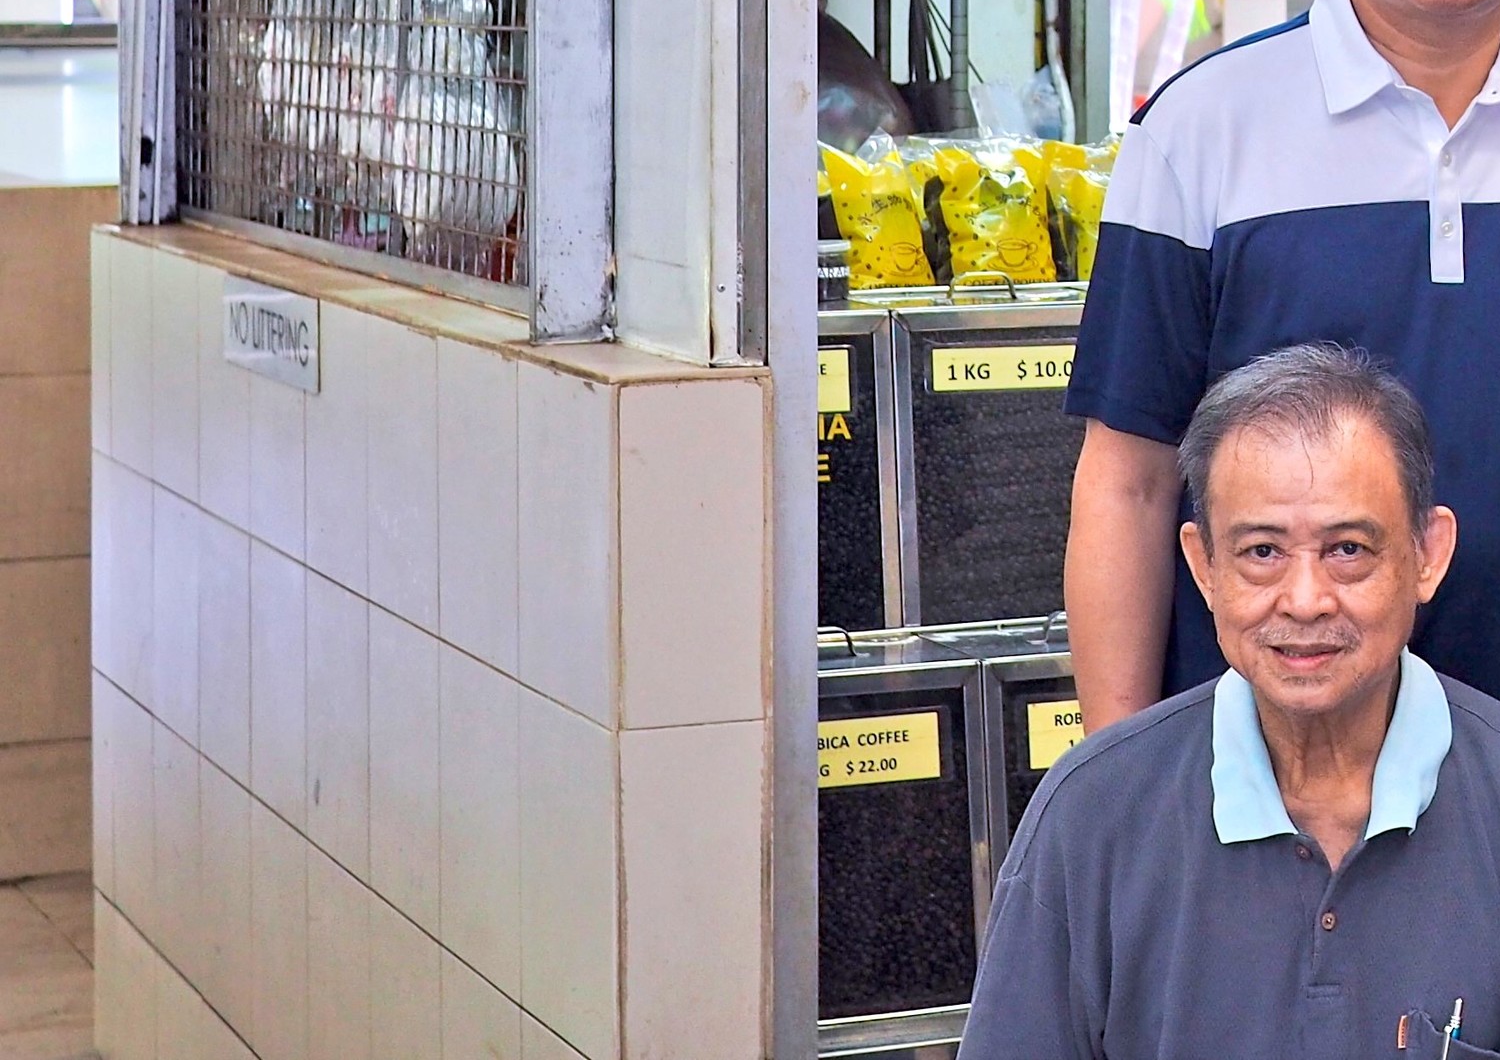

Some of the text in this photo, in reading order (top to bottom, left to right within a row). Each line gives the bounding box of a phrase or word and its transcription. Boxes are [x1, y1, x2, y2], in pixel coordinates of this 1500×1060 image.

[229, 301, 249, 345] NO
[948, 364, 957, 381] 1
[964, 363, 990, 380] KG
[857, 729, 910, 747] COFFEE
